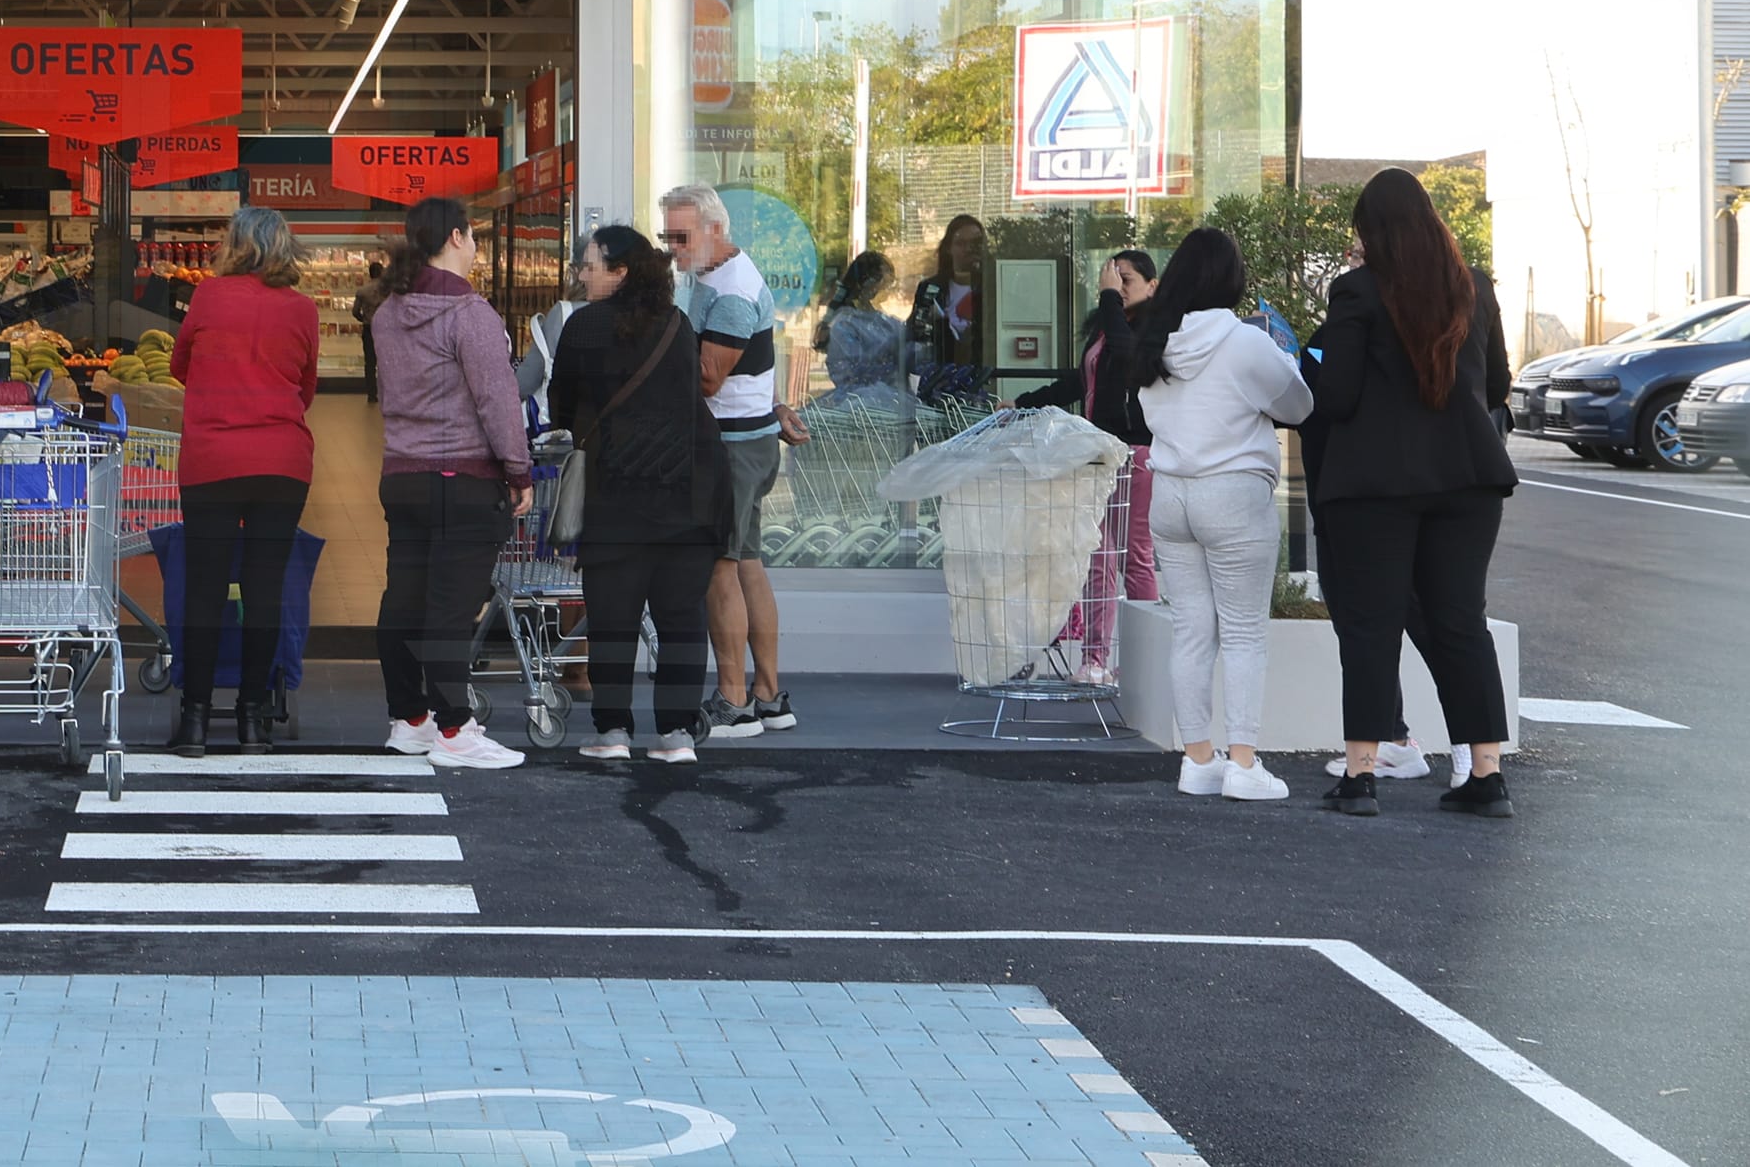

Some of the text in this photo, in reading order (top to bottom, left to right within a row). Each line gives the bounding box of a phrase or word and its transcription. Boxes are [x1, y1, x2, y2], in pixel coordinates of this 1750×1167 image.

[10, 42, 195, 77] OFERTAS
[147, 137, 222, 152] PIERDAS
[721, 128, 781, 140] INFORMA
[360, 145, 470, 166] OFERTAS
[251, 173, 317, 197] TERÍA
